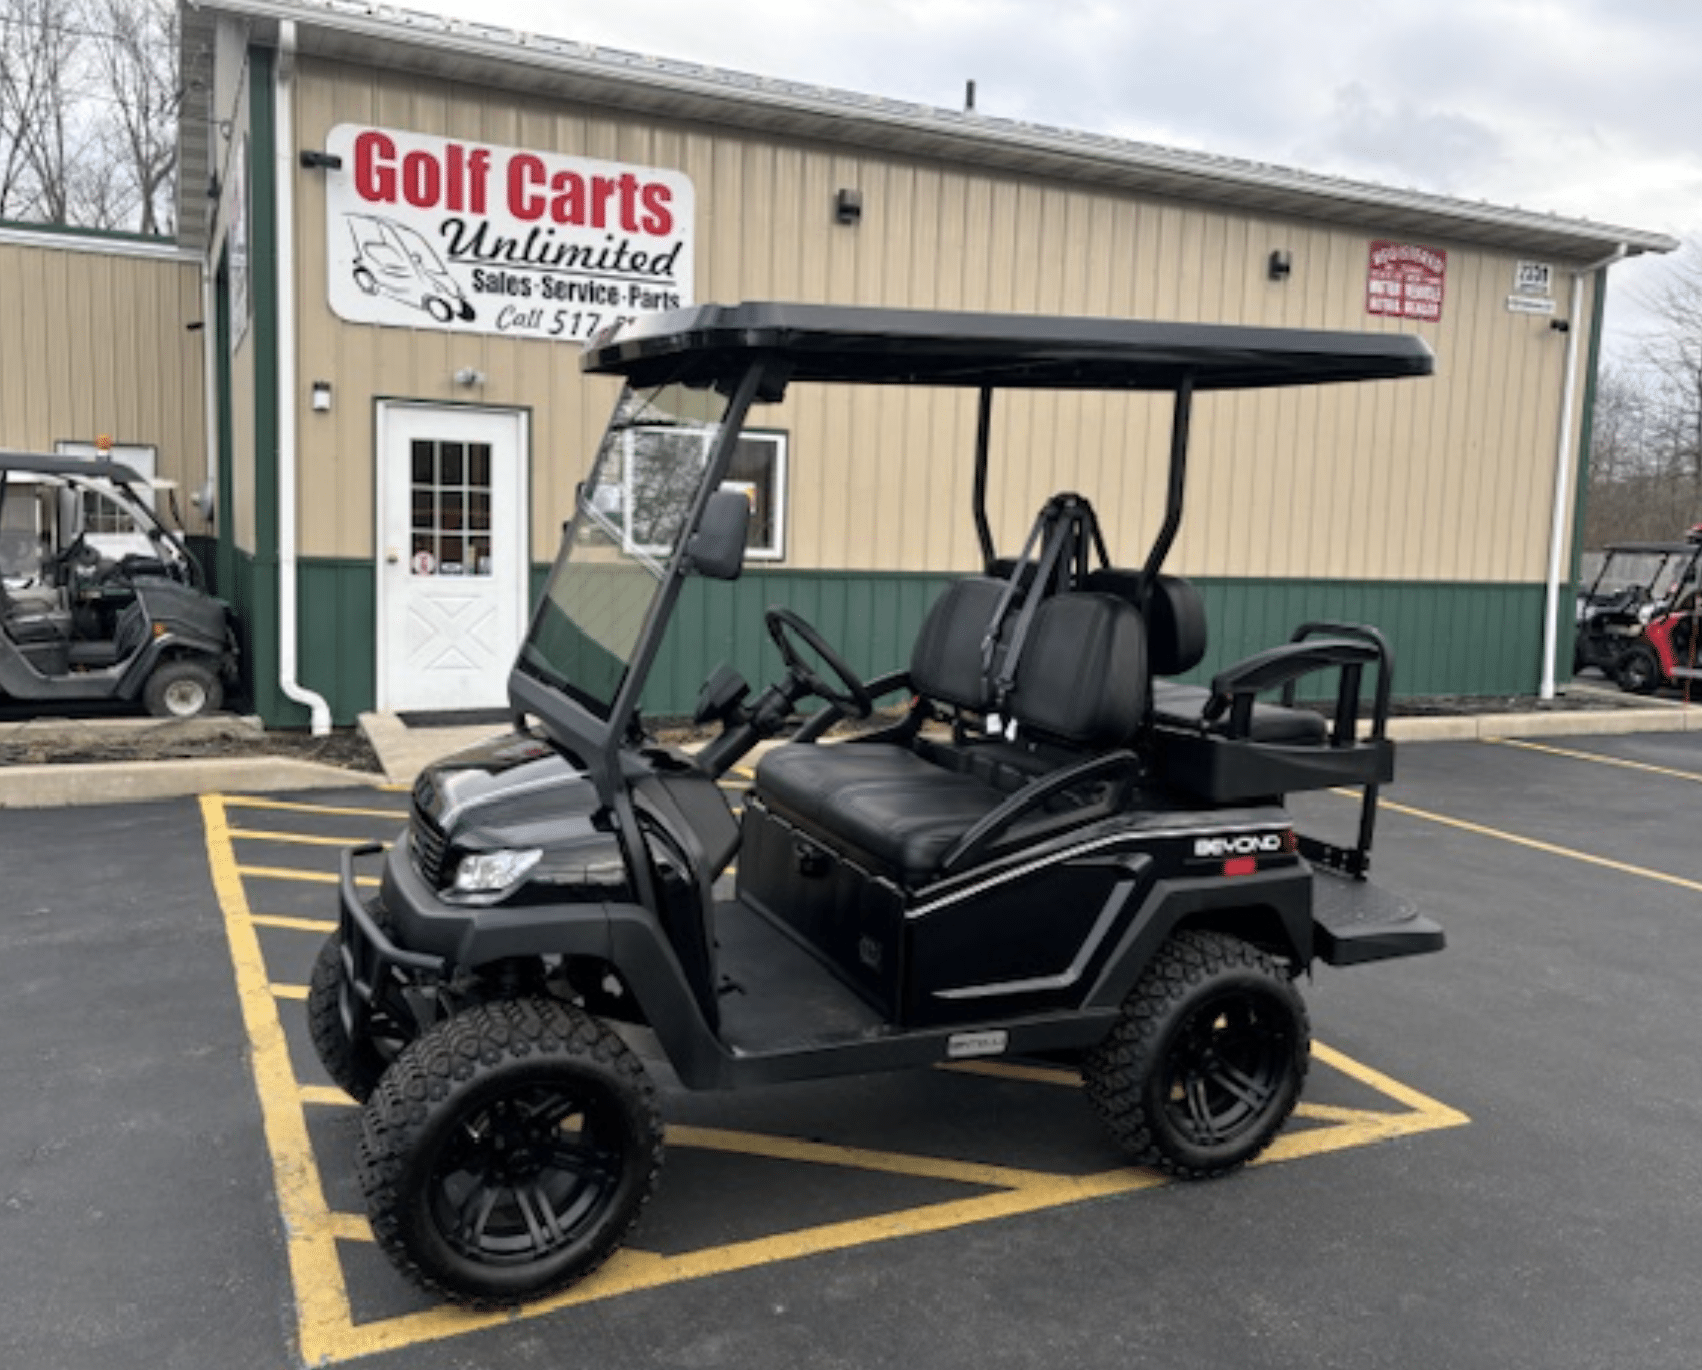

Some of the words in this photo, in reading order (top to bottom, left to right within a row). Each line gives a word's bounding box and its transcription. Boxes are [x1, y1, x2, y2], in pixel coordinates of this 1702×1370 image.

[354, 130, 491, 214] Golf
[506, 153, 673, 237] Carts
[439, 217, 684, 277] Unlimited
[495, 304, 544, 331] Call
